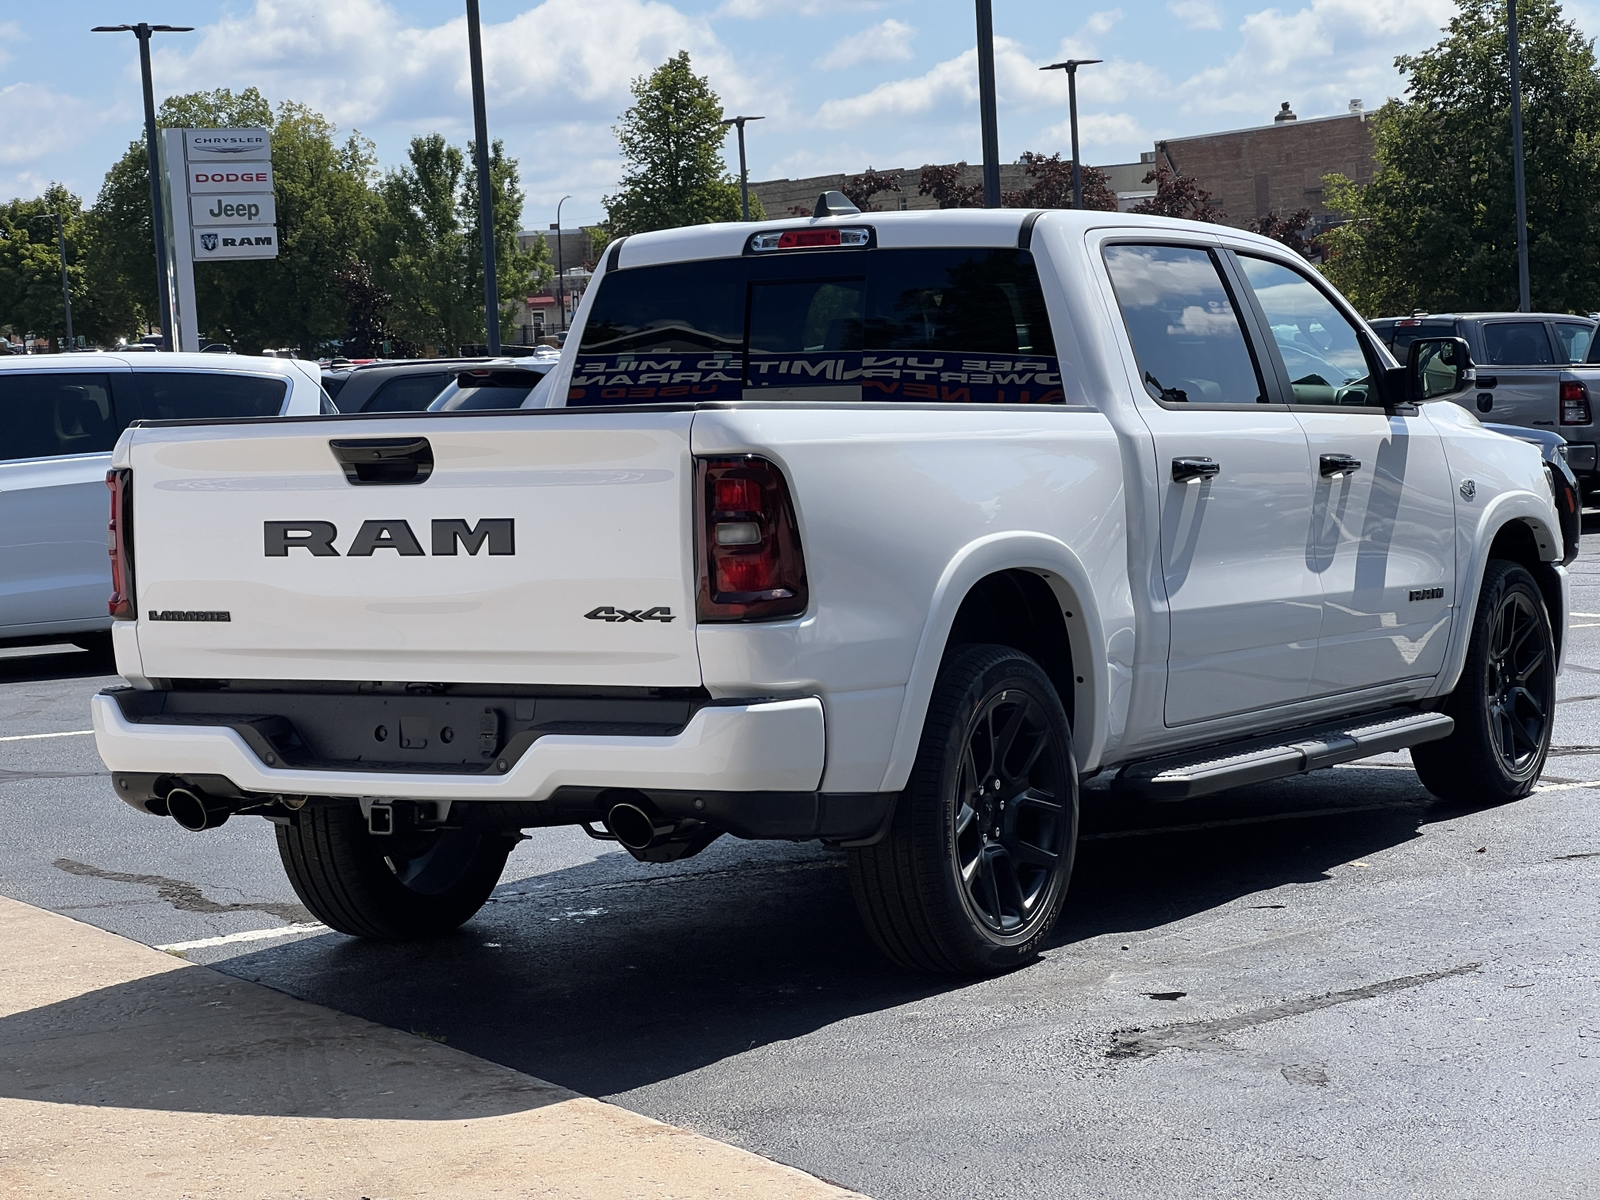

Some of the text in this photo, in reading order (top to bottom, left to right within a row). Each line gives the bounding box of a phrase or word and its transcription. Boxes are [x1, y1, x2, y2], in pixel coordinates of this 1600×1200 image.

[195, 172, 268, 182] DODGE
[209, 199, 260, 220] Jeep
[222, 236, 272, 247] RAM
[263, 518, 516, 557] RAM
[1408, 587, 1445, 602] RAM
[148, 610, 231, 623] LARAMIE
[583, 606, 677, 623] 4x4
